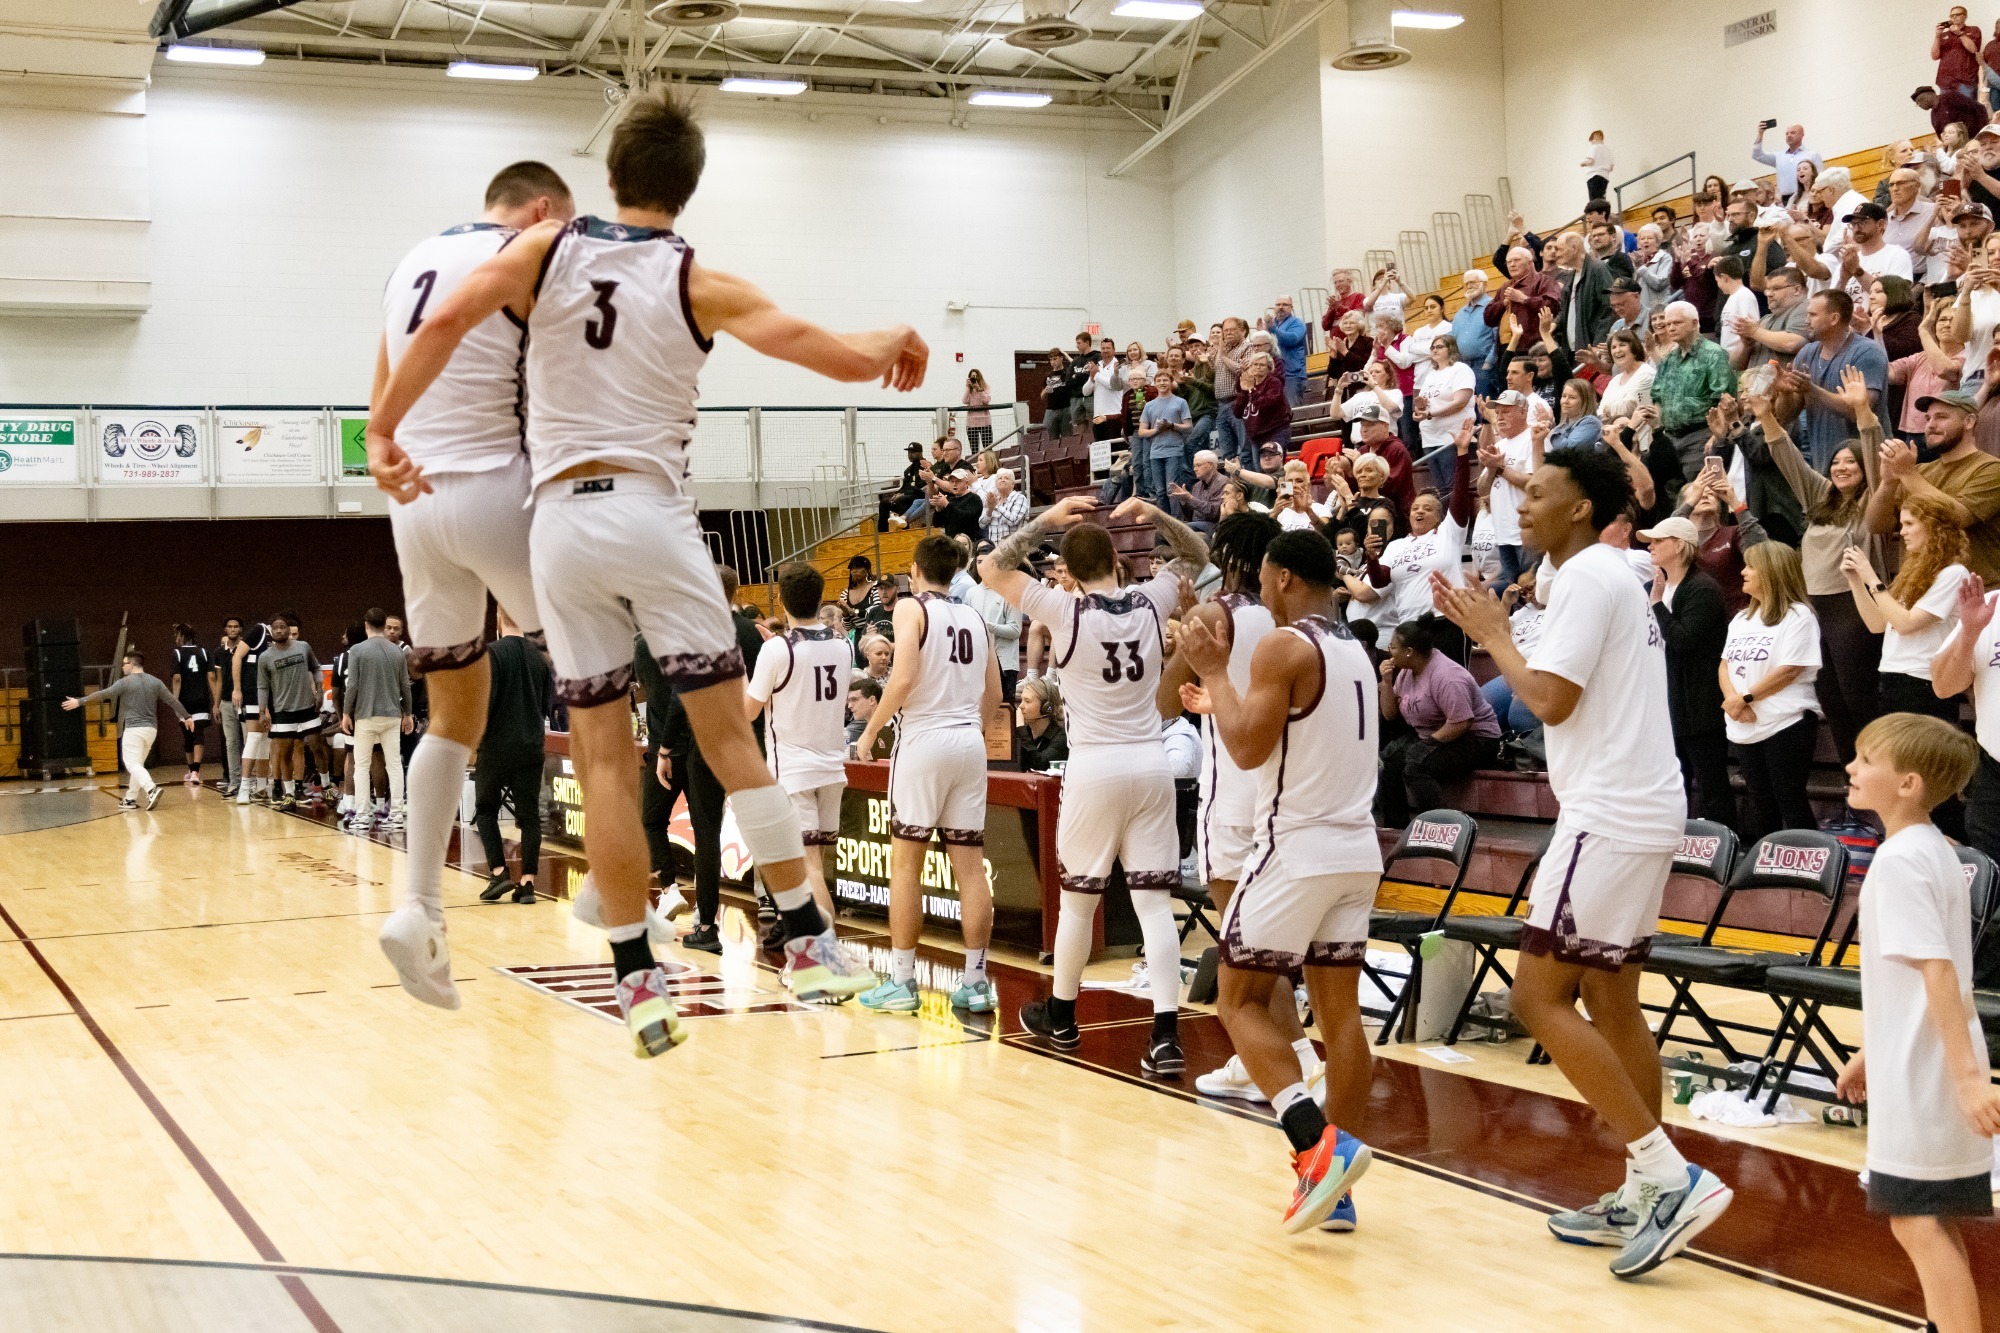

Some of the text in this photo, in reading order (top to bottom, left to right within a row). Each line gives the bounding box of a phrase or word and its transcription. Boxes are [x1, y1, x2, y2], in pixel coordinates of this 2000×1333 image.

[406, 270, 437, 334] 2
[585, 280, 620, 350] 3
[26, 422, 71, 432] DRUG
[123, 470, 180, 478] 731-989-2837
[946, 625, 974, 665] 20
[1726, 648, 1769, 663] ARNED
[188, 655, 199, 672] 4
[1101, 640, 1145, 683] 33
[814, 664, 838, 702] 13
[1354, 680, 1365, 740] 1
[553, 777, 583, 805] SMITH-
[565, 809, 585, 837] COU
[1408, 819, 1461, 846] LIONS
[836, 837, 893, 879] SPORT
[1674, 835, 1720, 860] ONS
[1755, 841, 1830, 873] LIONS
